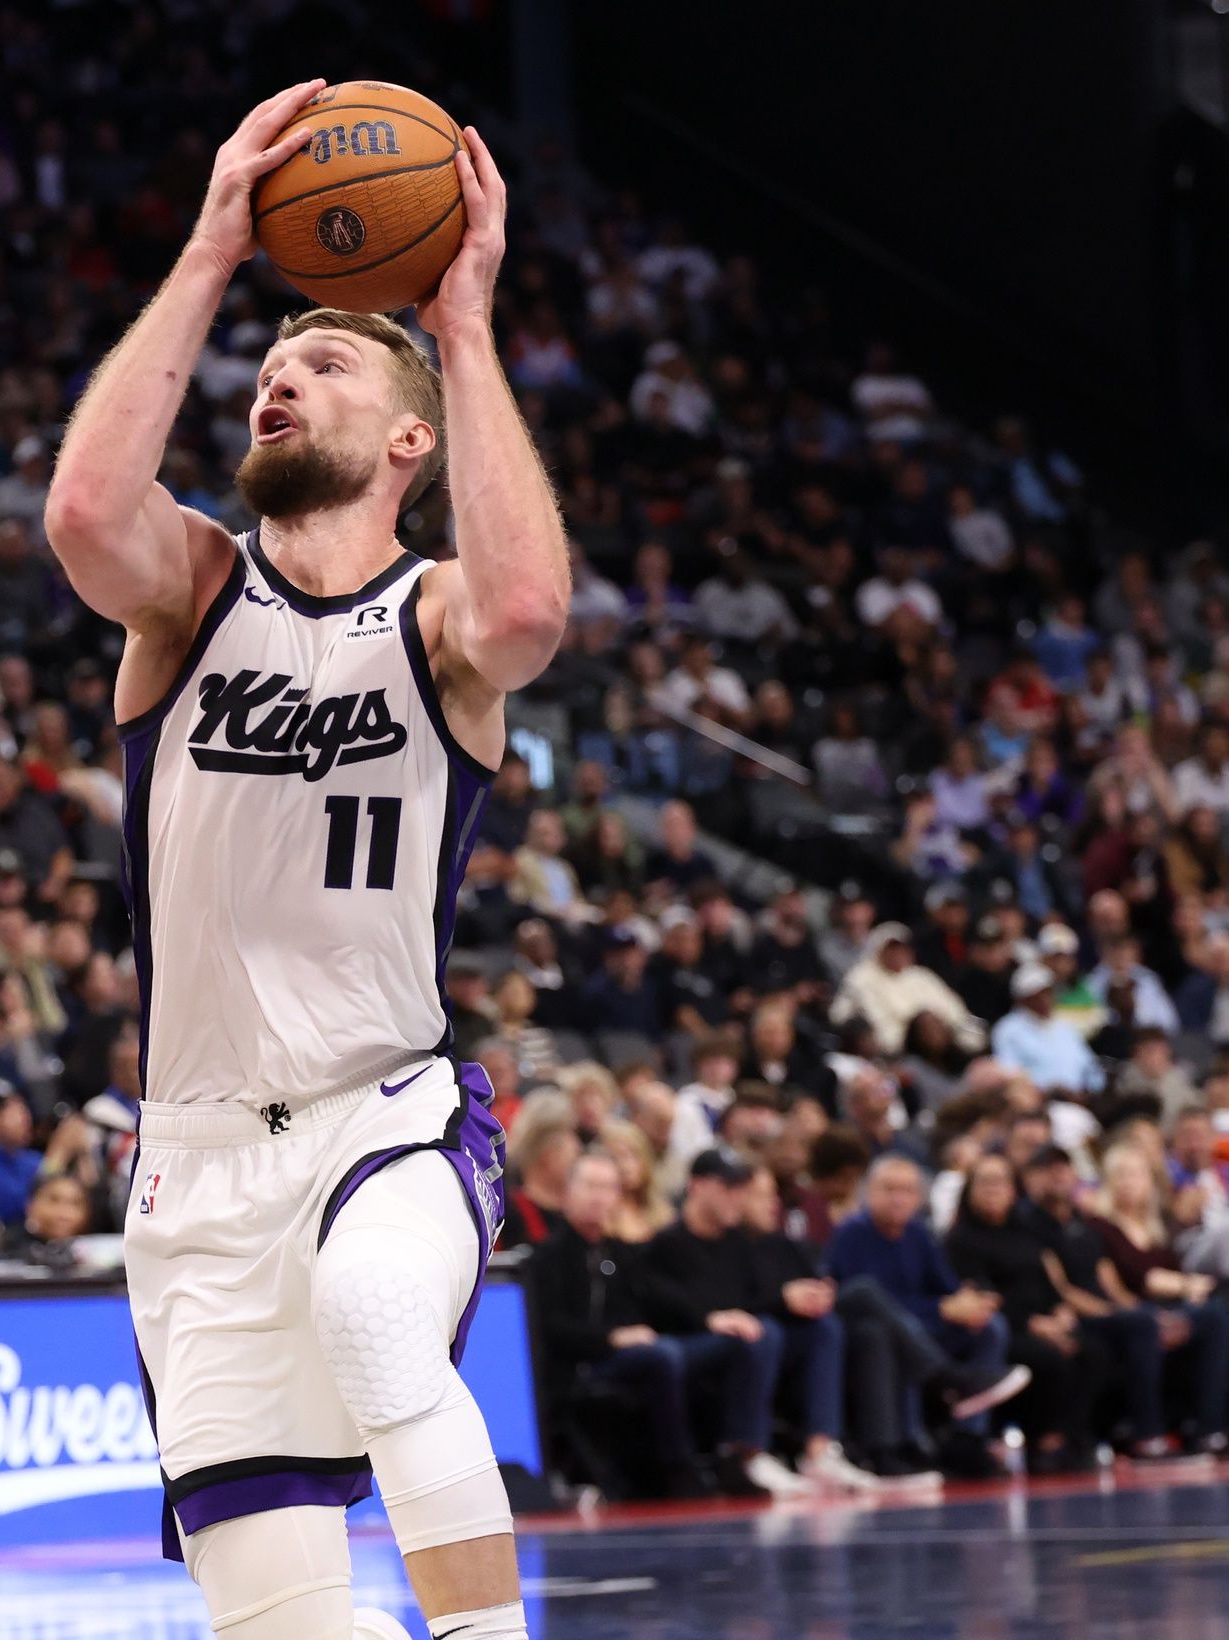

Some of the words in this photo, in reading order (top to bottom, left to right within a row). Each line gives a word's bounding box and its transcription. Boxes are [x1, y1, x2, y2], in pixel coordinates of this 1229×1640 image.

[347, 626, 393, 638] REVIVER
[188, 669, 407, 782] Kings
[324, 795, 402, 890] 11
